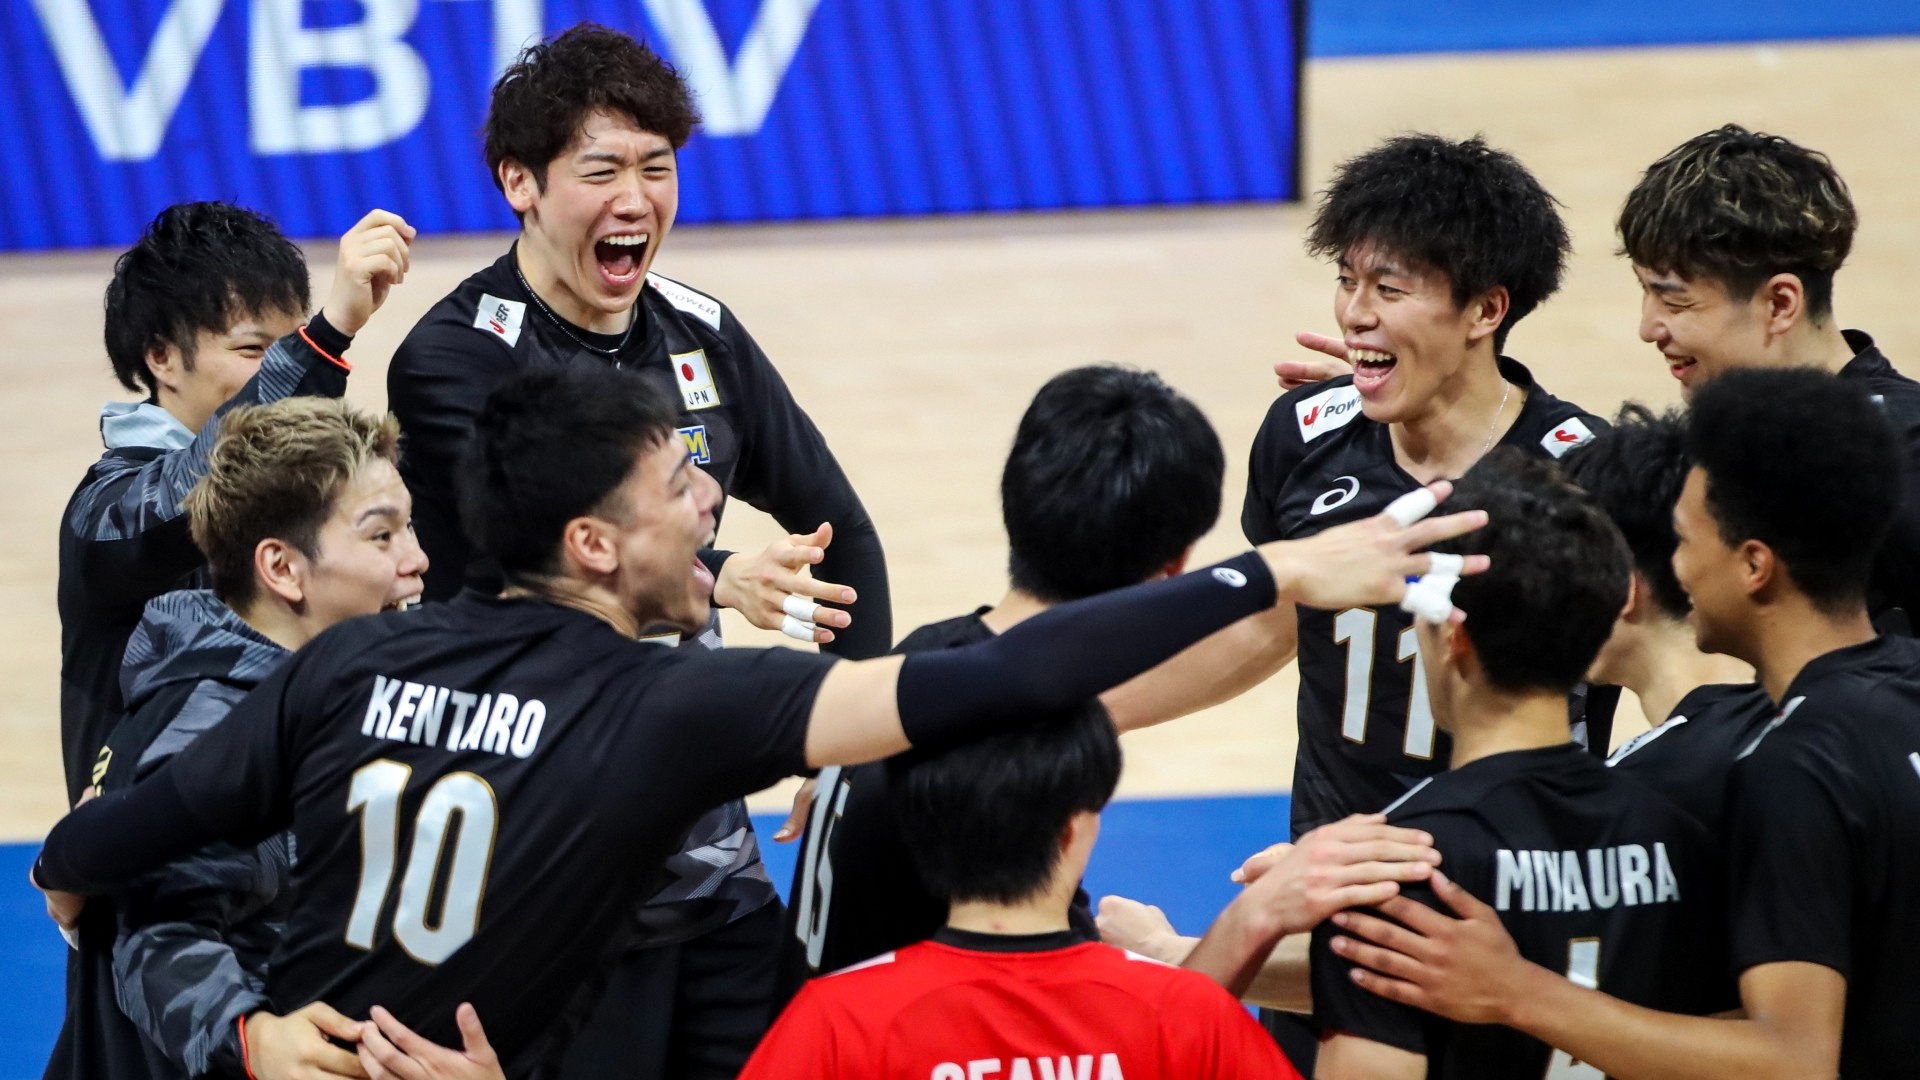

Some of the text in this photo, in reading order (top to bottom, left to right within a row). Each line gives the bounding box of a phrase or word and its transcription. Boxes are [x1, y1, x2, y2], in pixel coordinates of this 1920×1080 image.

[688, 390, 710, 405] JPN
[361, 674, 547, 759] KENTARO
[1333, 606, 1438, 761] 11
[344, 757, 499, 967] 10
[1495, 842, 1682, 912] MIYAURA
